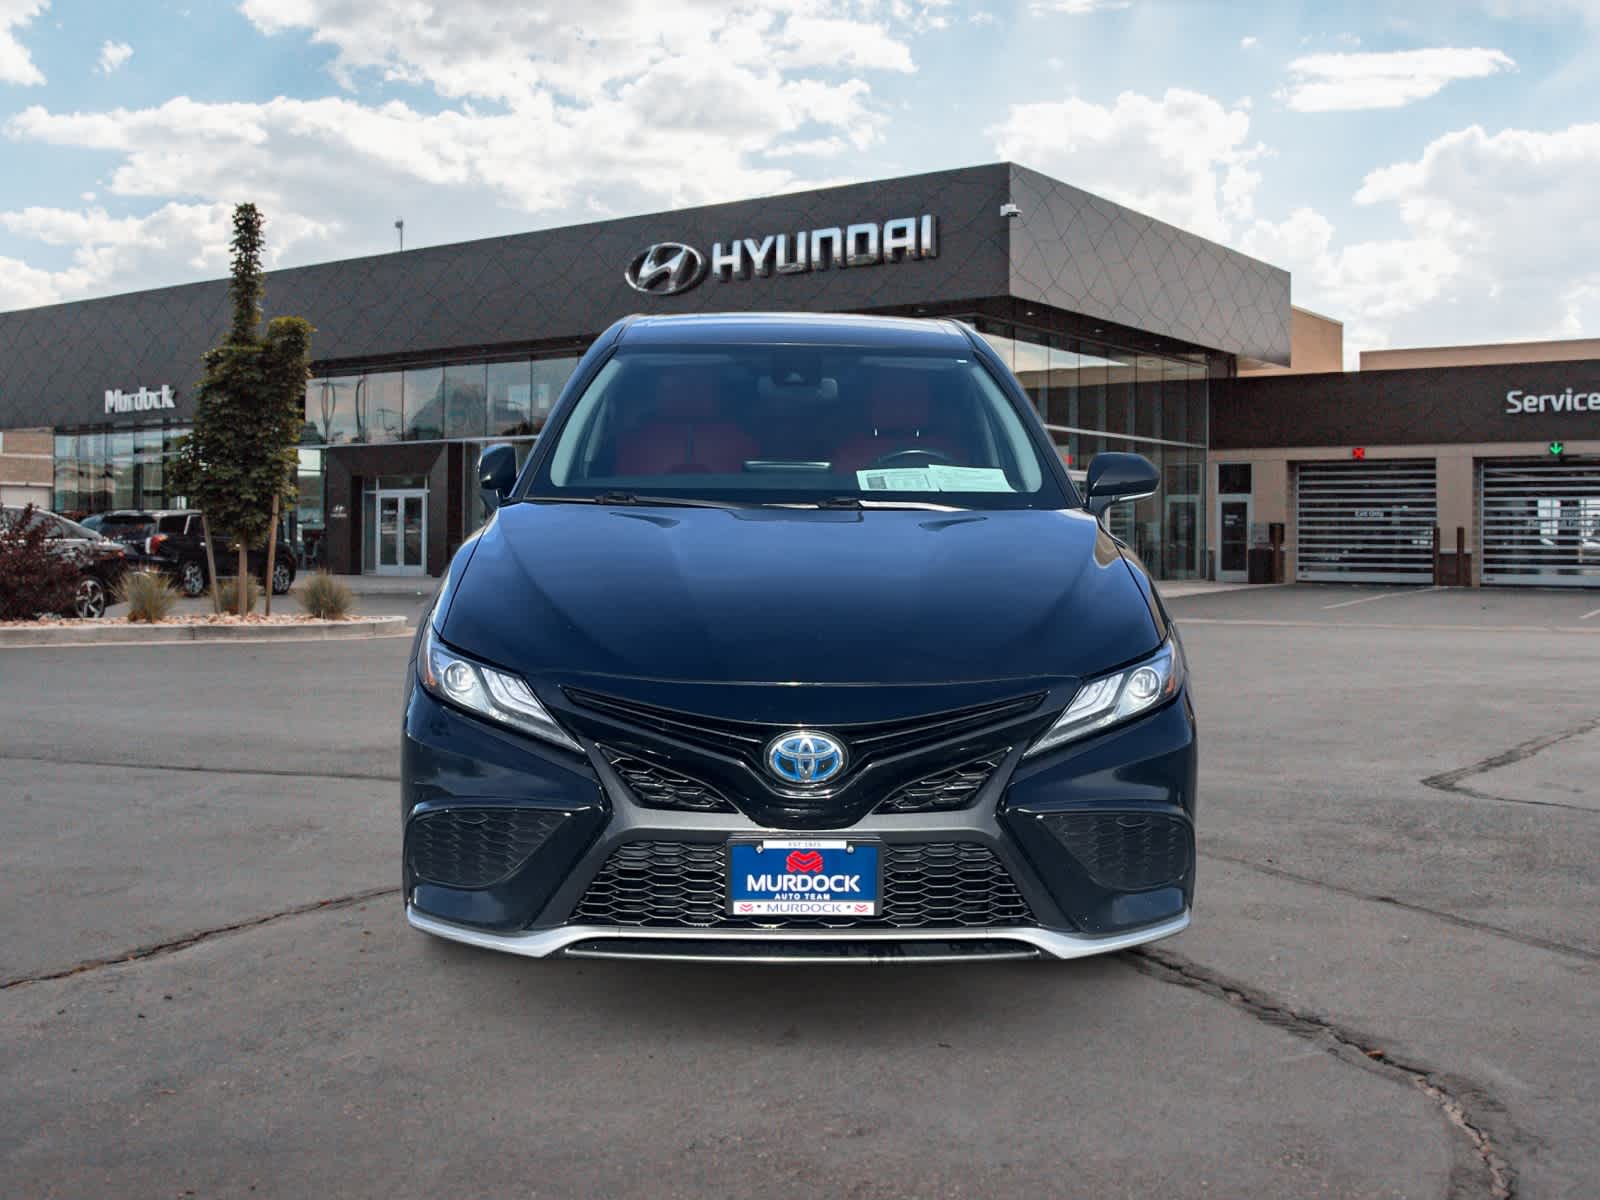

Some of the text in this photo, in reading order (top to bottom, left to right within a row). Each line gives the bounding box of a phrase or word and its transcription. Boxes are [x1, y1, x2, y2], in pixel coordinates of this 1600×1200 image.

[712, 214, 937, 282] HYUNDAI
[104, 384, 176, 414] Murdock
[1505, 387, 1600, 414] Service
[746, 874, 860, 893] MURDOCK
[766, 903, 842, 913] MURDOCK
[774, 893, 831, 901] AUTO TEAM
